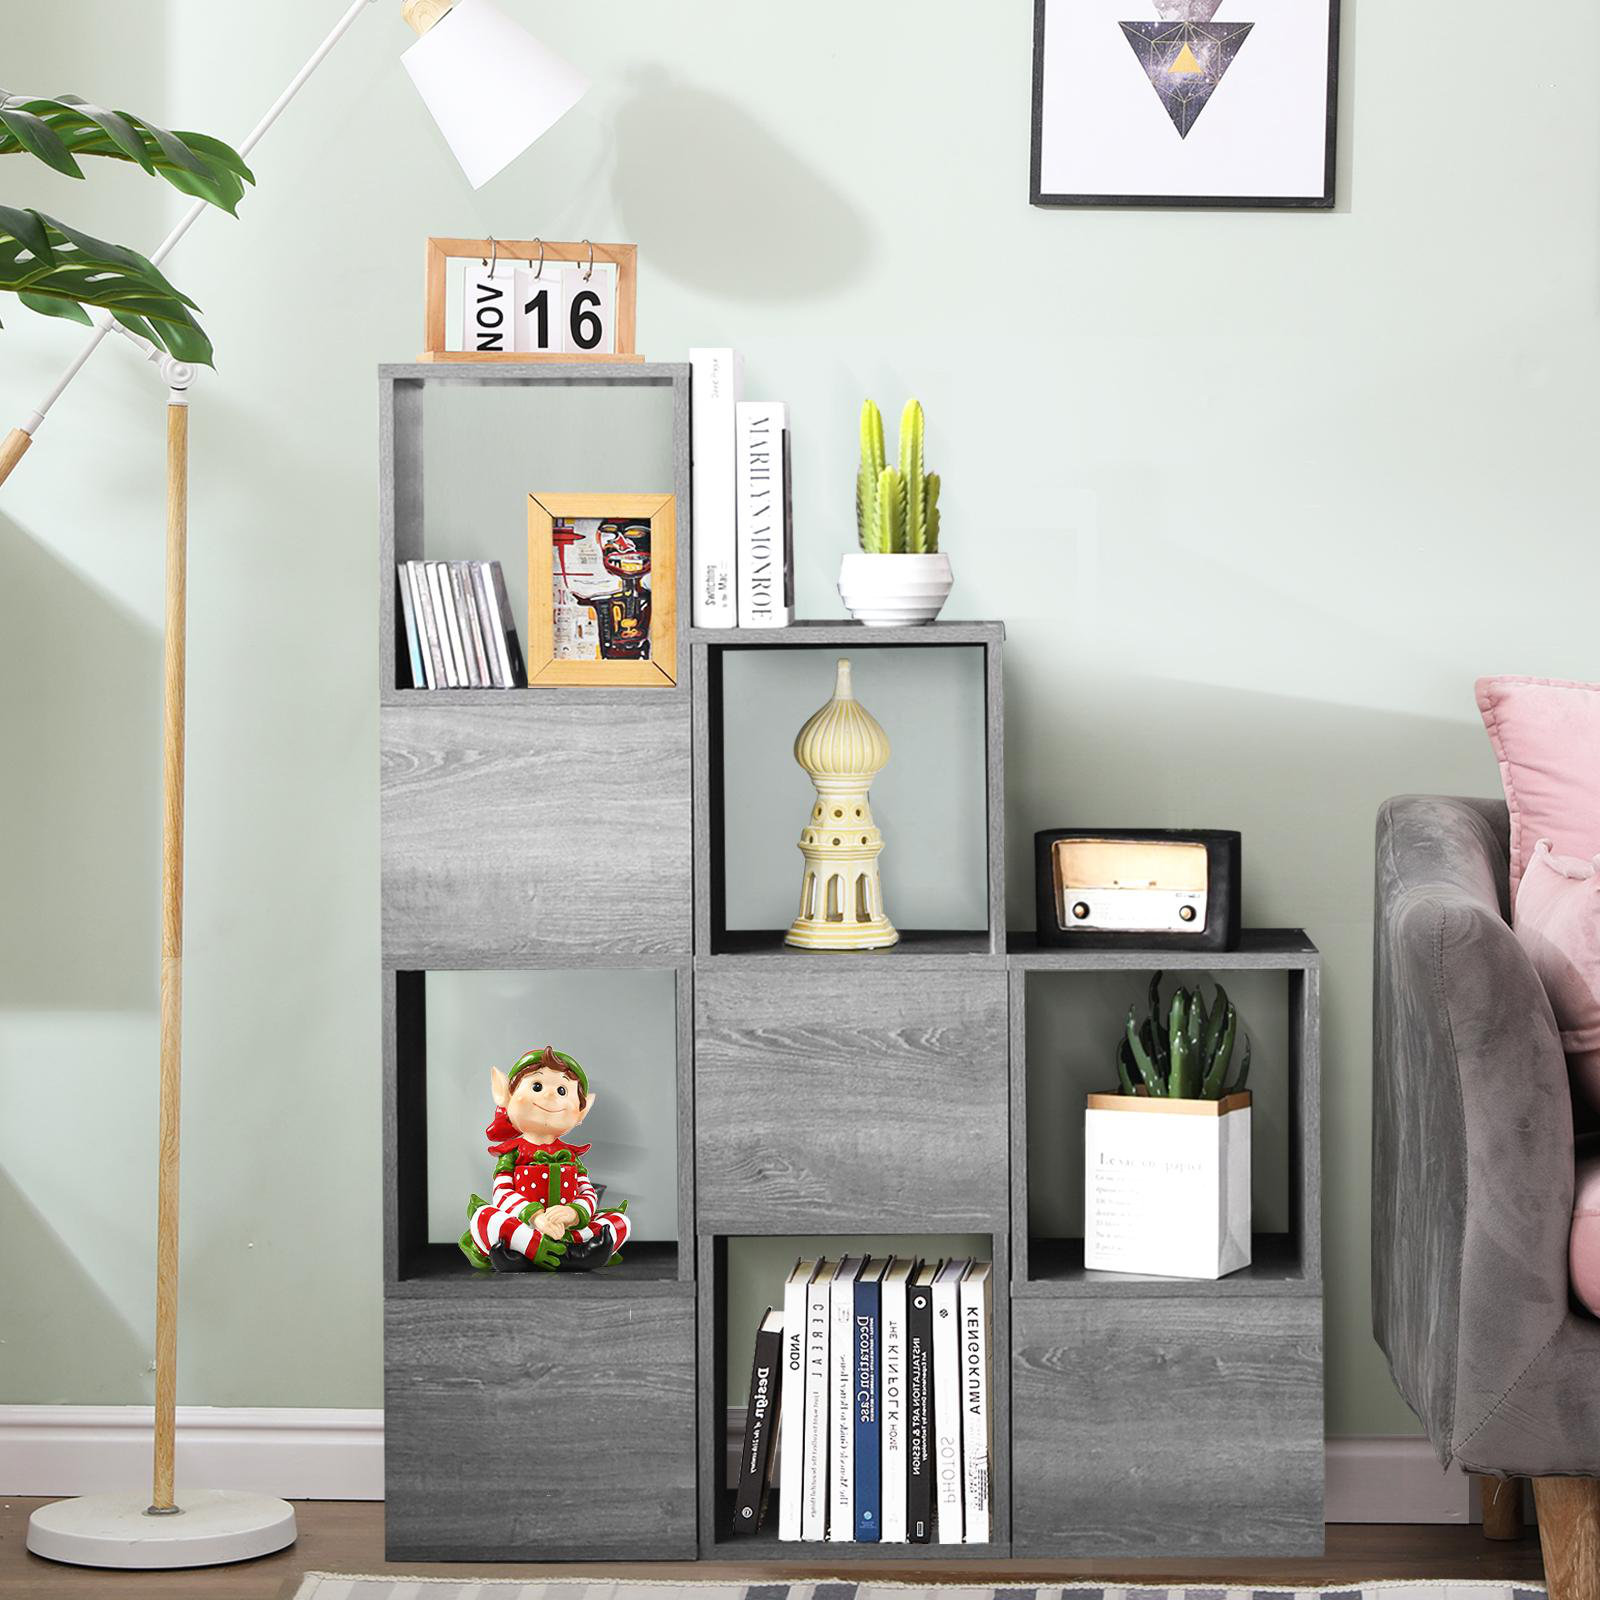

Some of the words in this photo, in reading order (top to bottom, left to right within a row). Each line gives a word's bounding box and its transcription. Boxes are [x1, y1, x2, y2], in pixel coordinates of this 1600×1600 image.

[476, 284, 504, 351] NOV
[749, 416, 770, 517] MARILYN
[751, 526, 772, 621] MONROE
